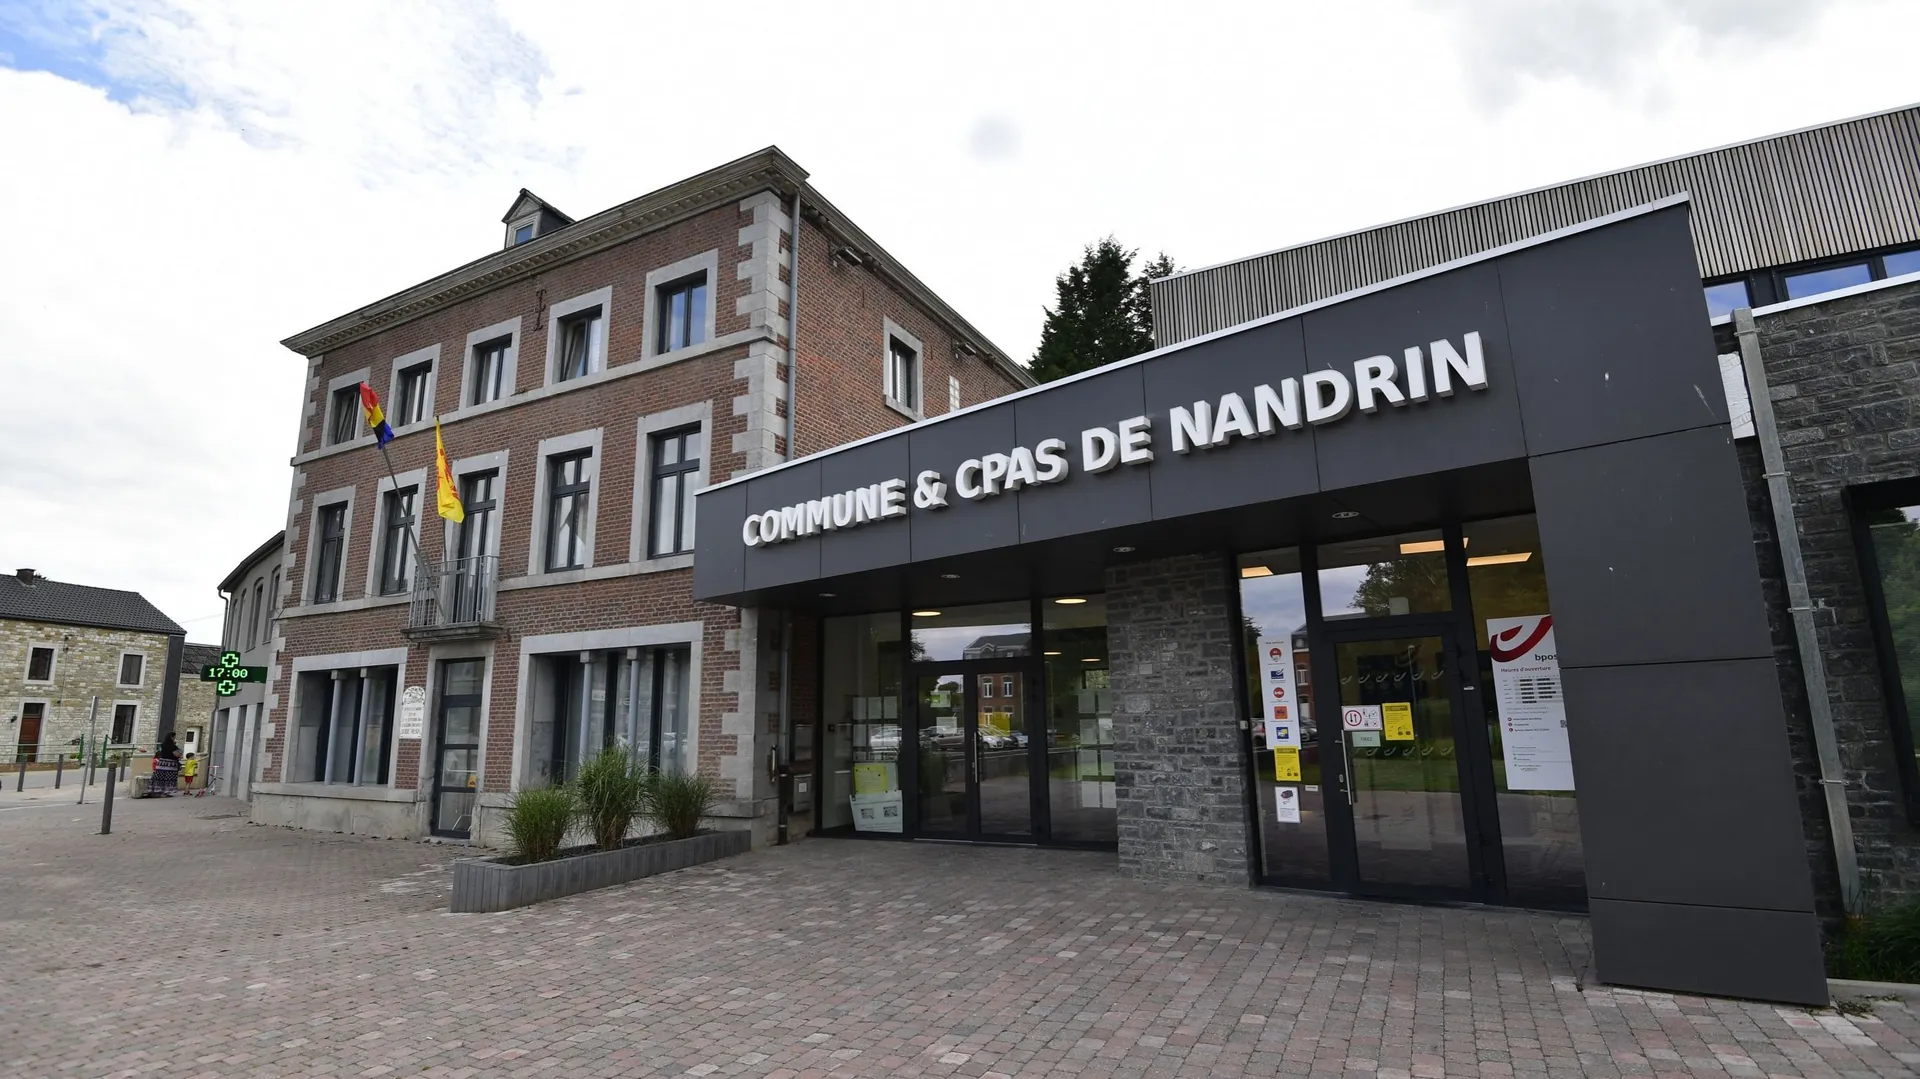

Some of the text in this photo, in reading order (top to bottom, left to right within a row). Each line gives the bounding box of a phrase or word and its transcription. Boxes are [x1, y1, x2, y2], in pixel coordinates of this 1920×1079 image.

[742, 330, 1488, 548] COMMUNE & CPAS DE NANDRIN
[208, 667, 248, 678] 17:00
